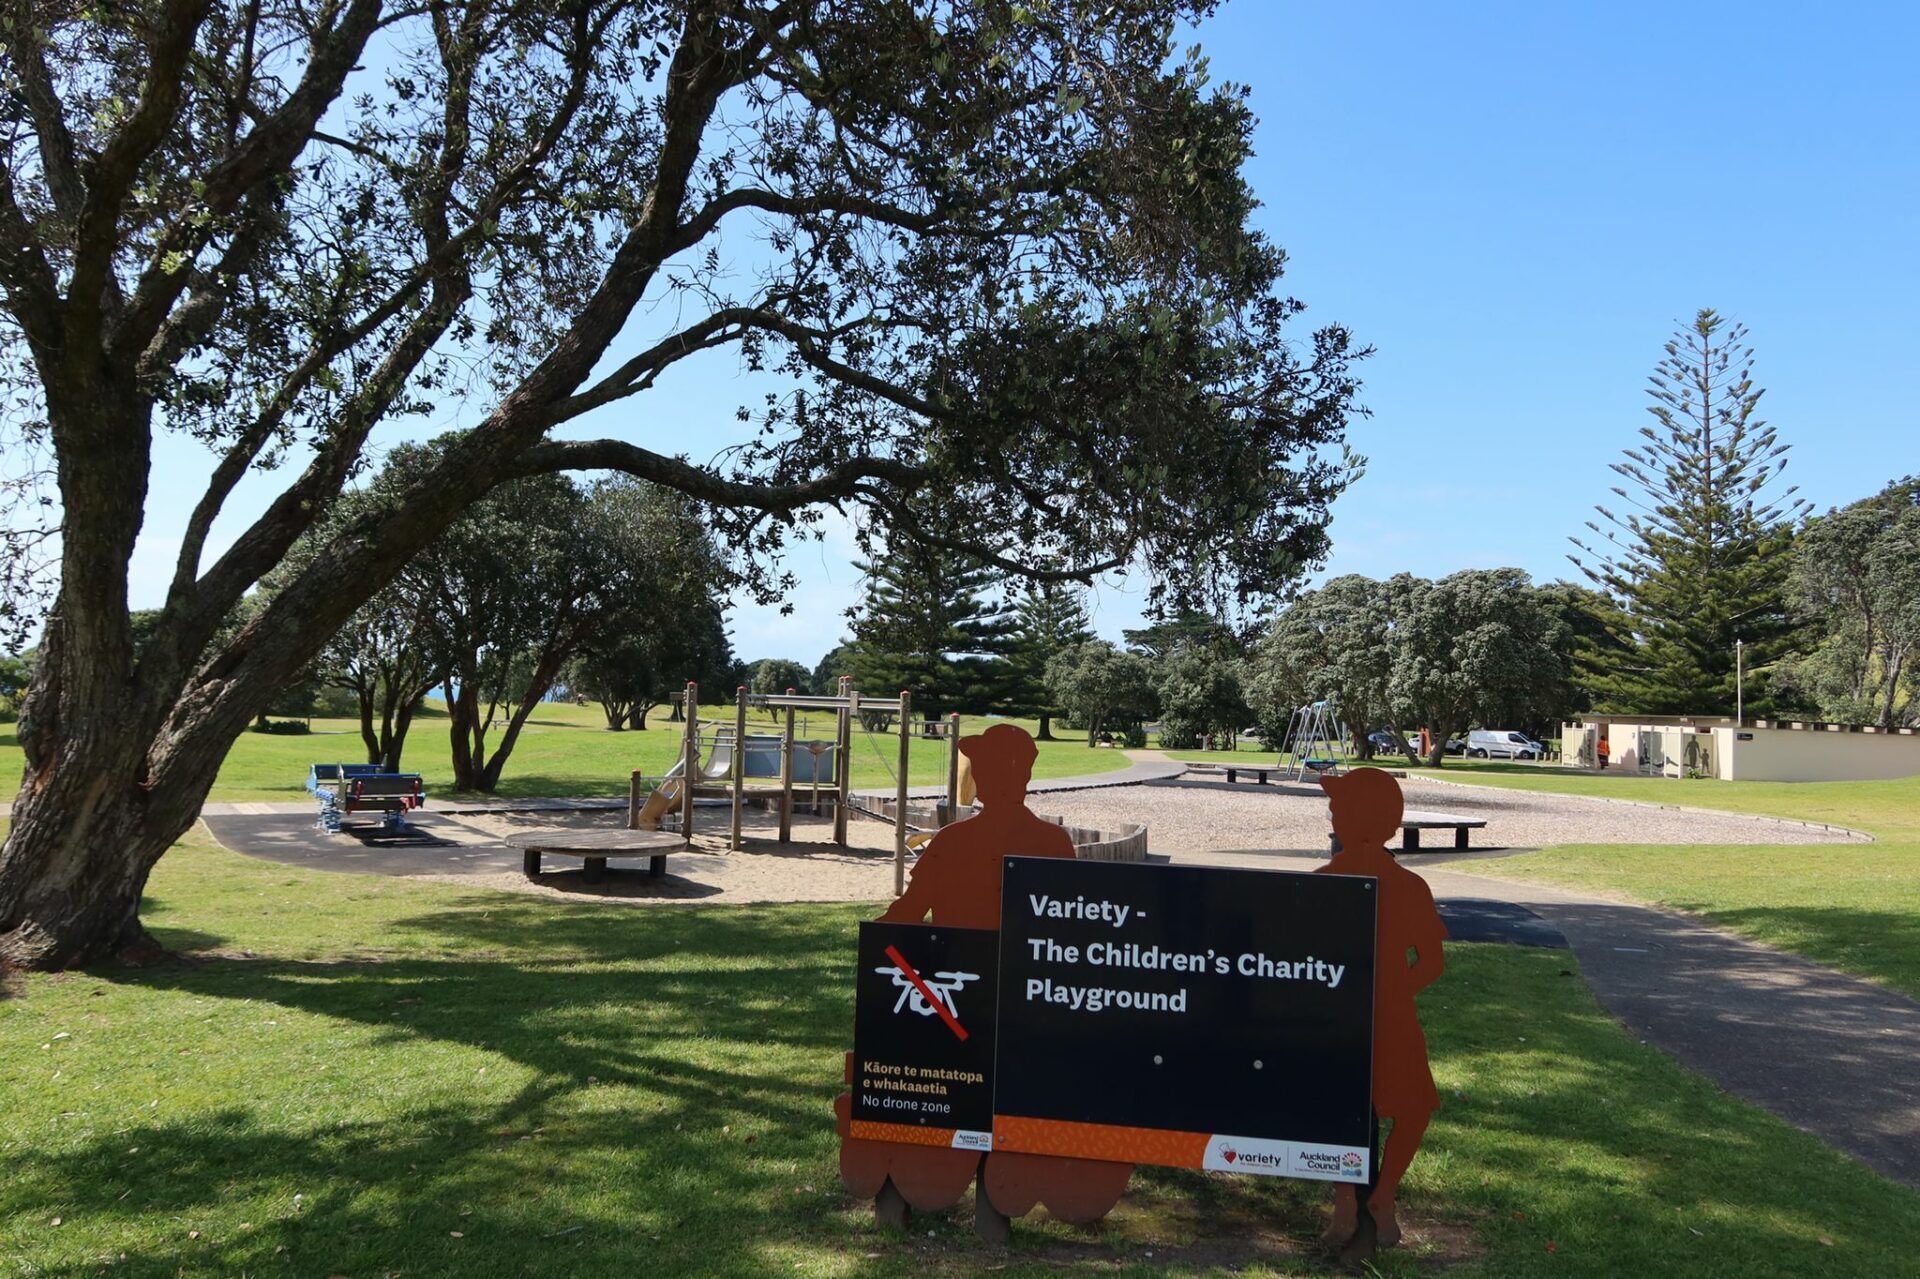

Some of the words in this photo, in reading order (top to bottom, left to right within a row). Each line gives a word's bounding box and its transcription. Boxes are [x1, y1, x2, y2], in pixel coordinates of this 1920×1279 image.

[1029, 894, 1130, 928] Variety
[1136, 910, 1146, 918] -
[1027, 938, 1079, 963] The
[1086, 942, 1230, 974] Children’s
[1237, 953, 1345, 988] Charity
[1026, 978, 1187, 1012] Playground
[863, 1061, 901, 1075] Kāore
[904, 1065, 917, 1077] te
[920, 1068, 984, 1084] matatopa
[863, 1078, 870, 1088] e
[873, 1078, 948, 1095] whakaaetia
[862, 1095, 880, 1107] No
[882, 1096, 918, 1110] drone
[921, 1102, 951, 1113] zone
[1238, 1153, 1281, 1166] variety
[1299, 1151, 1341, 1163] Auckland
[1307, 1160, 1341, 1171] Council
